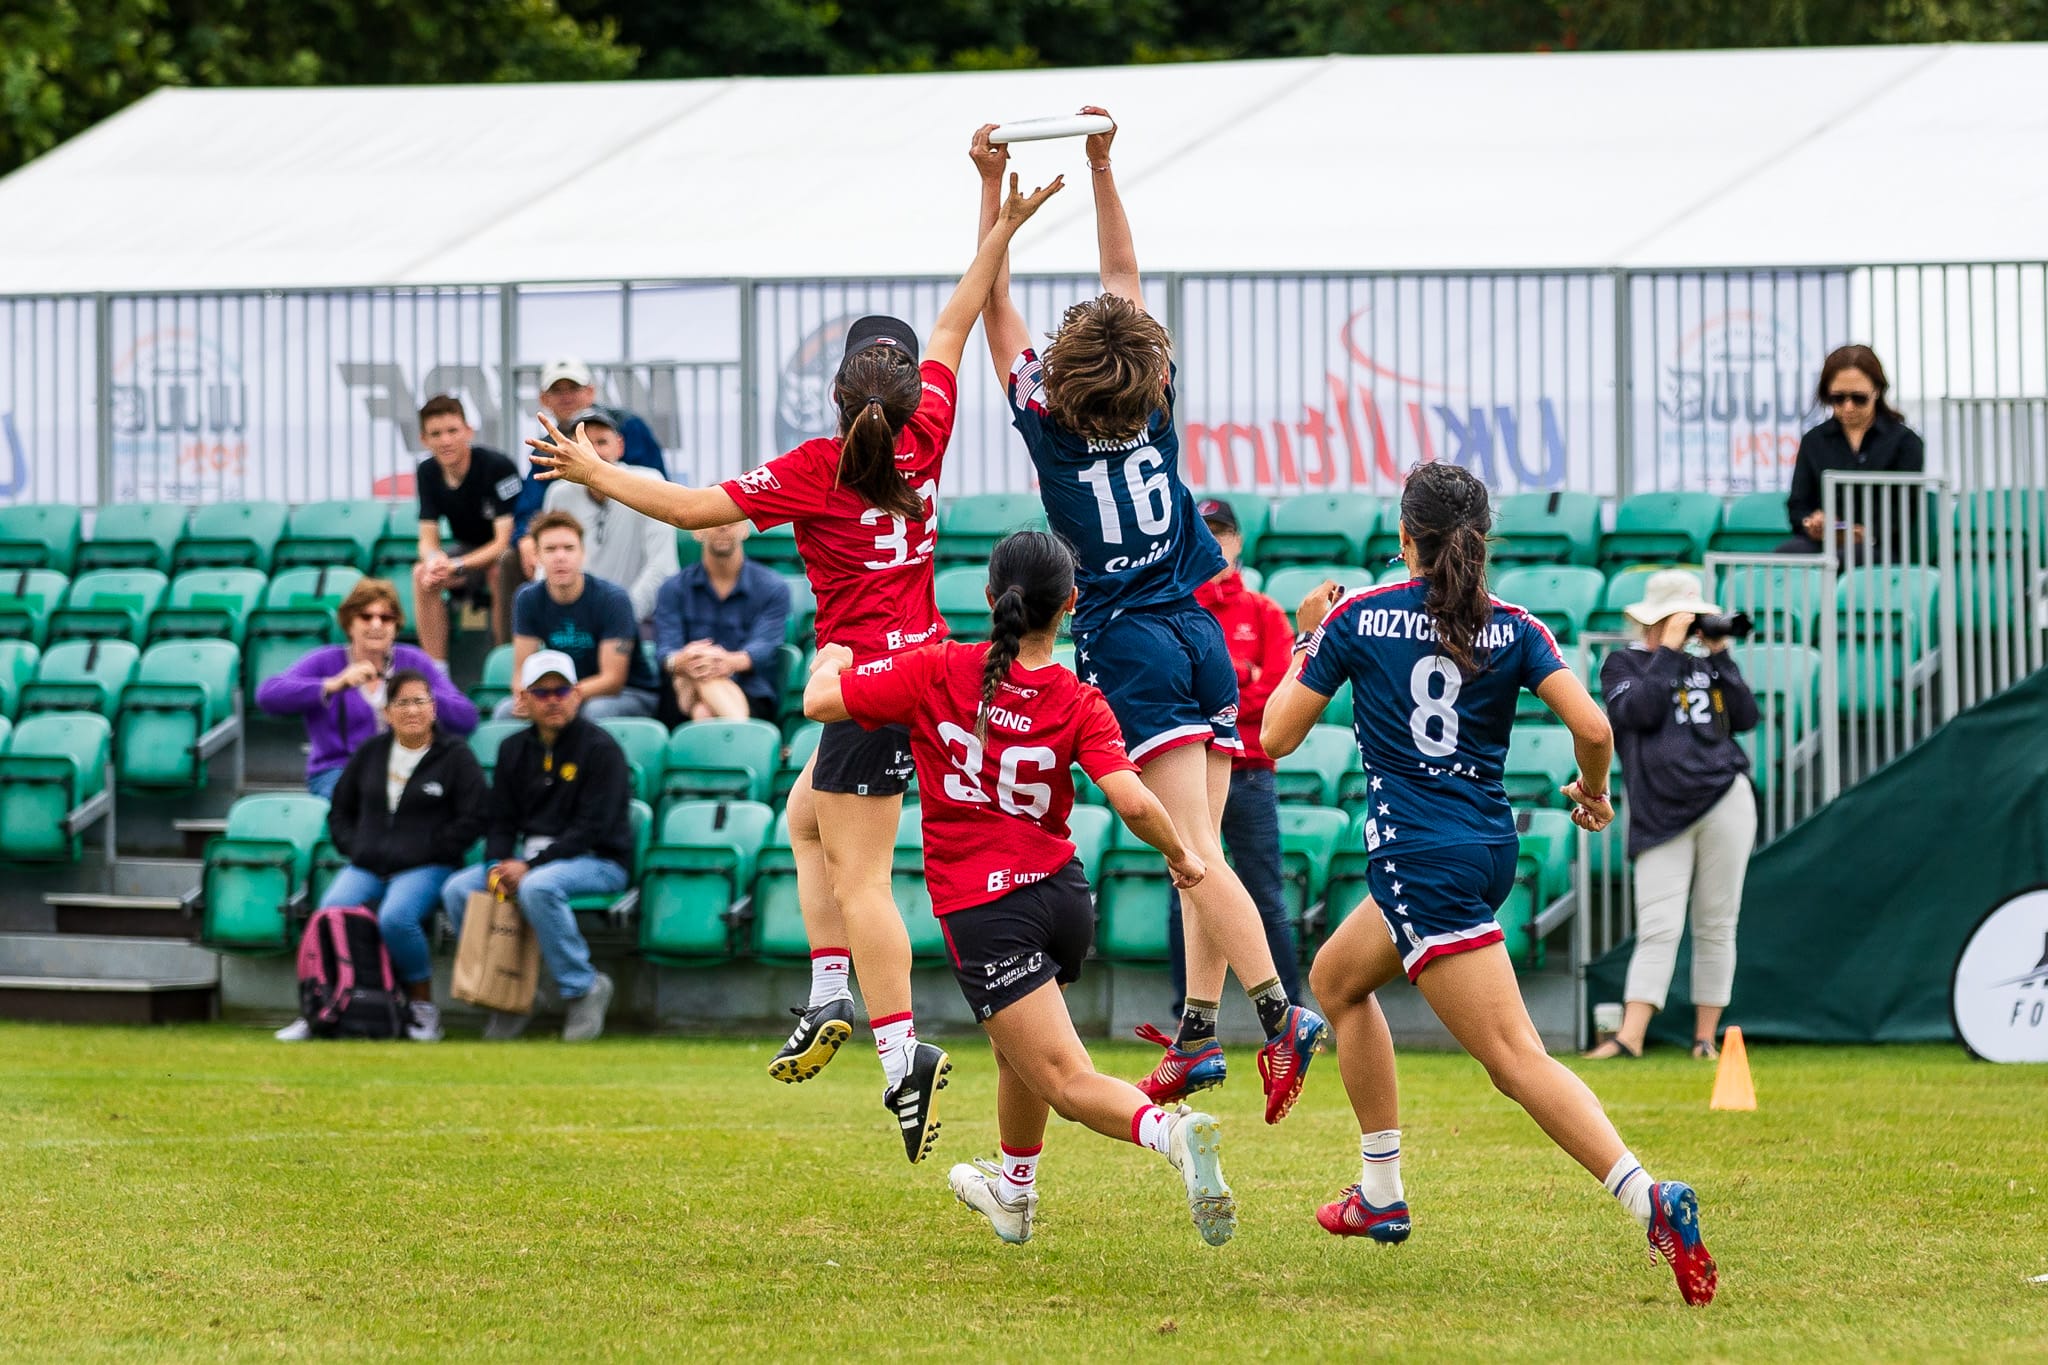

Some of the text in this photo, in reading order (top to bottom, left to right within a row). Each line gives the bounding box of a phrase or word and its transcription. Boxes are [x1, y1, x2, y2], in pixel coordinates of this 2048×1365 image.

[1078, 445, 1172, 544] 16
[977, 700, 1032, 732] WONG
[1409, 655, 1462, 757] 8
[937, 721, 1056, 819] 36
